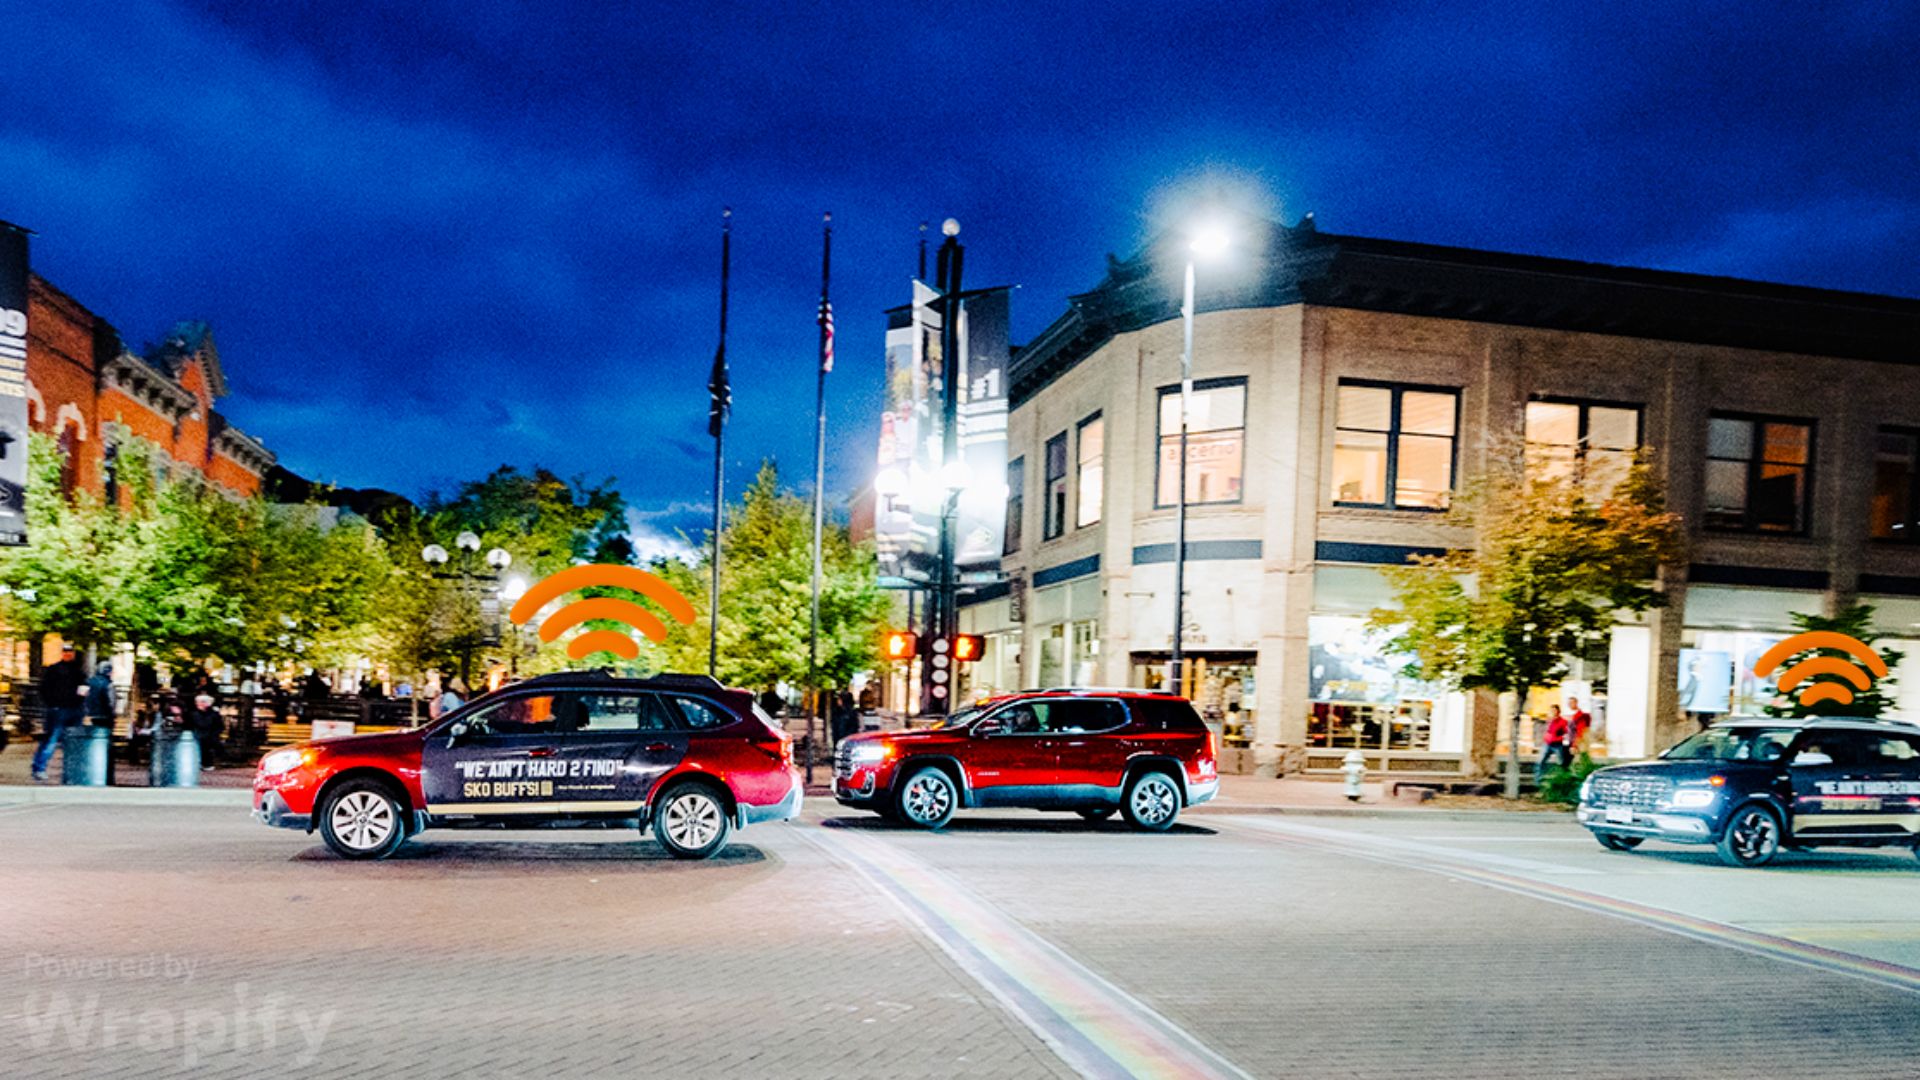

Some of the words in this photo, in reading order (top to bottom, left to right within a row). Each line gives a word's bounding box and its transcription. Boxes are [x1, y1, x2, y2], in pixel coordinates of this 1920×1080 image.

[488, 761, 525, 777] AIN'T
[529, 760, 567, 777] HARD
[570, 760, 580, 777] 2
[464, 782, 491, 797] SKO
[494, 781, 539, 797] BUFFS!
